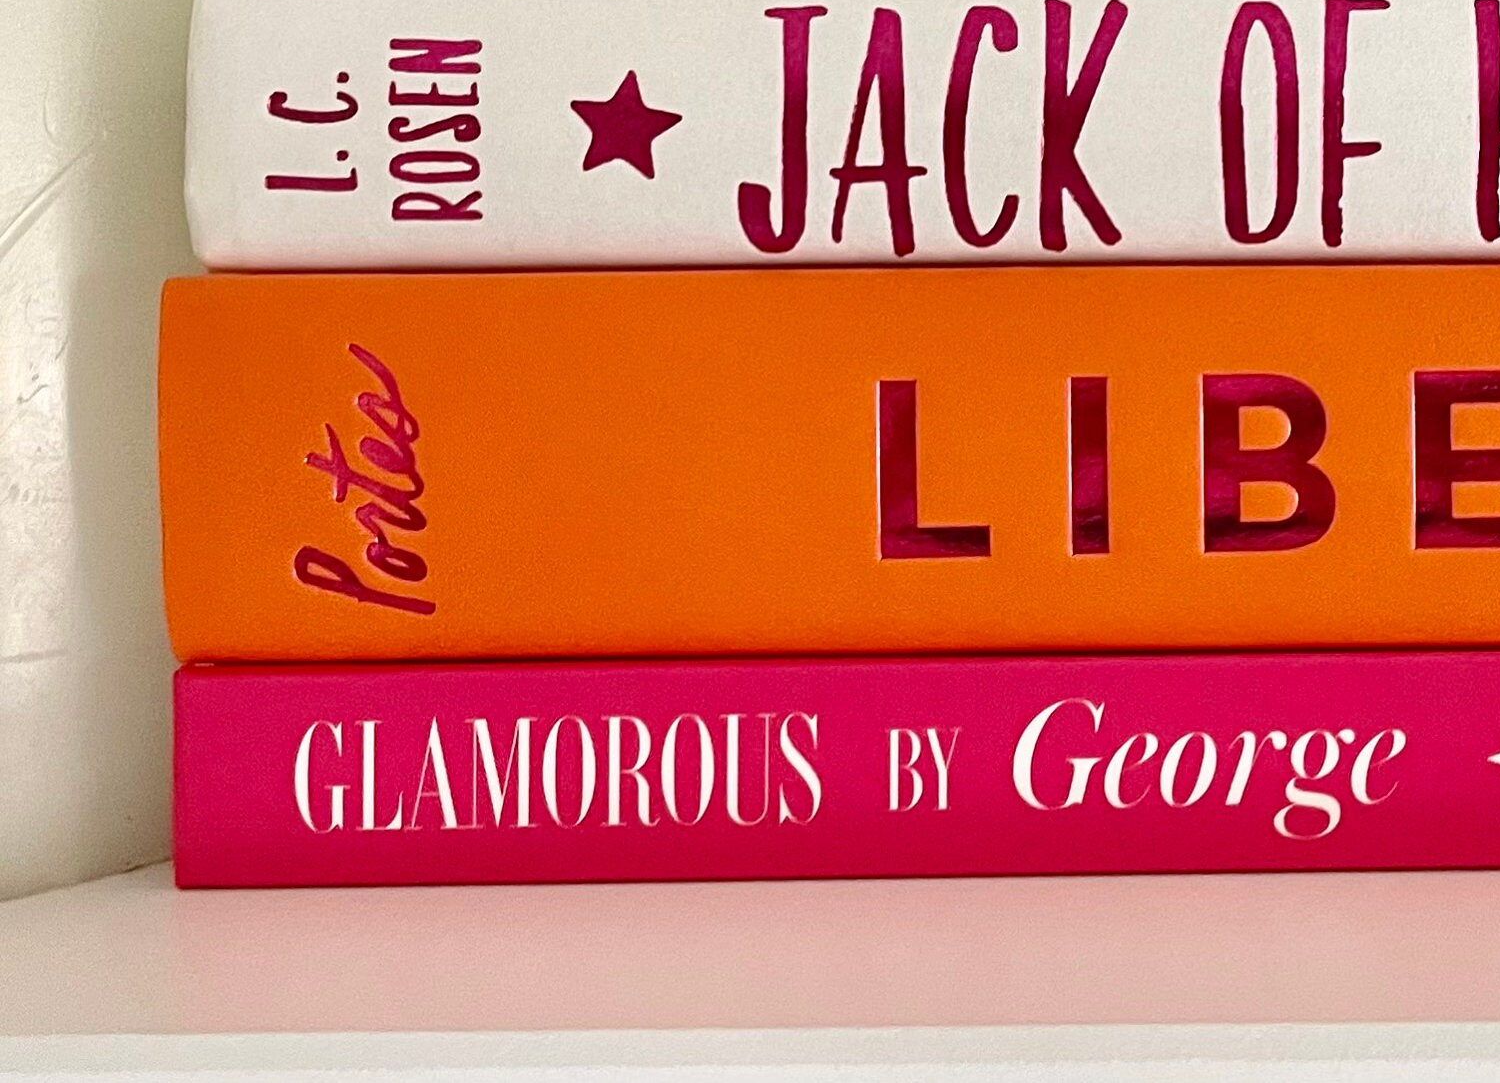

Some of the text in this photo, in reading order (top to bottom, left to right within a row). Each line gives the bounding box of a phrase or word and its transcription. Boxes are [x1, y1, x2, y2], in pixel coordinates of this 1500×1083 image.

[264, 70, 360, 193] L. C.
[388, 37, 484, 223] ROSEN
[291, 342, 437, 616] Portes
[294, 697, 1408, 839] GLAMOROUS BY George
